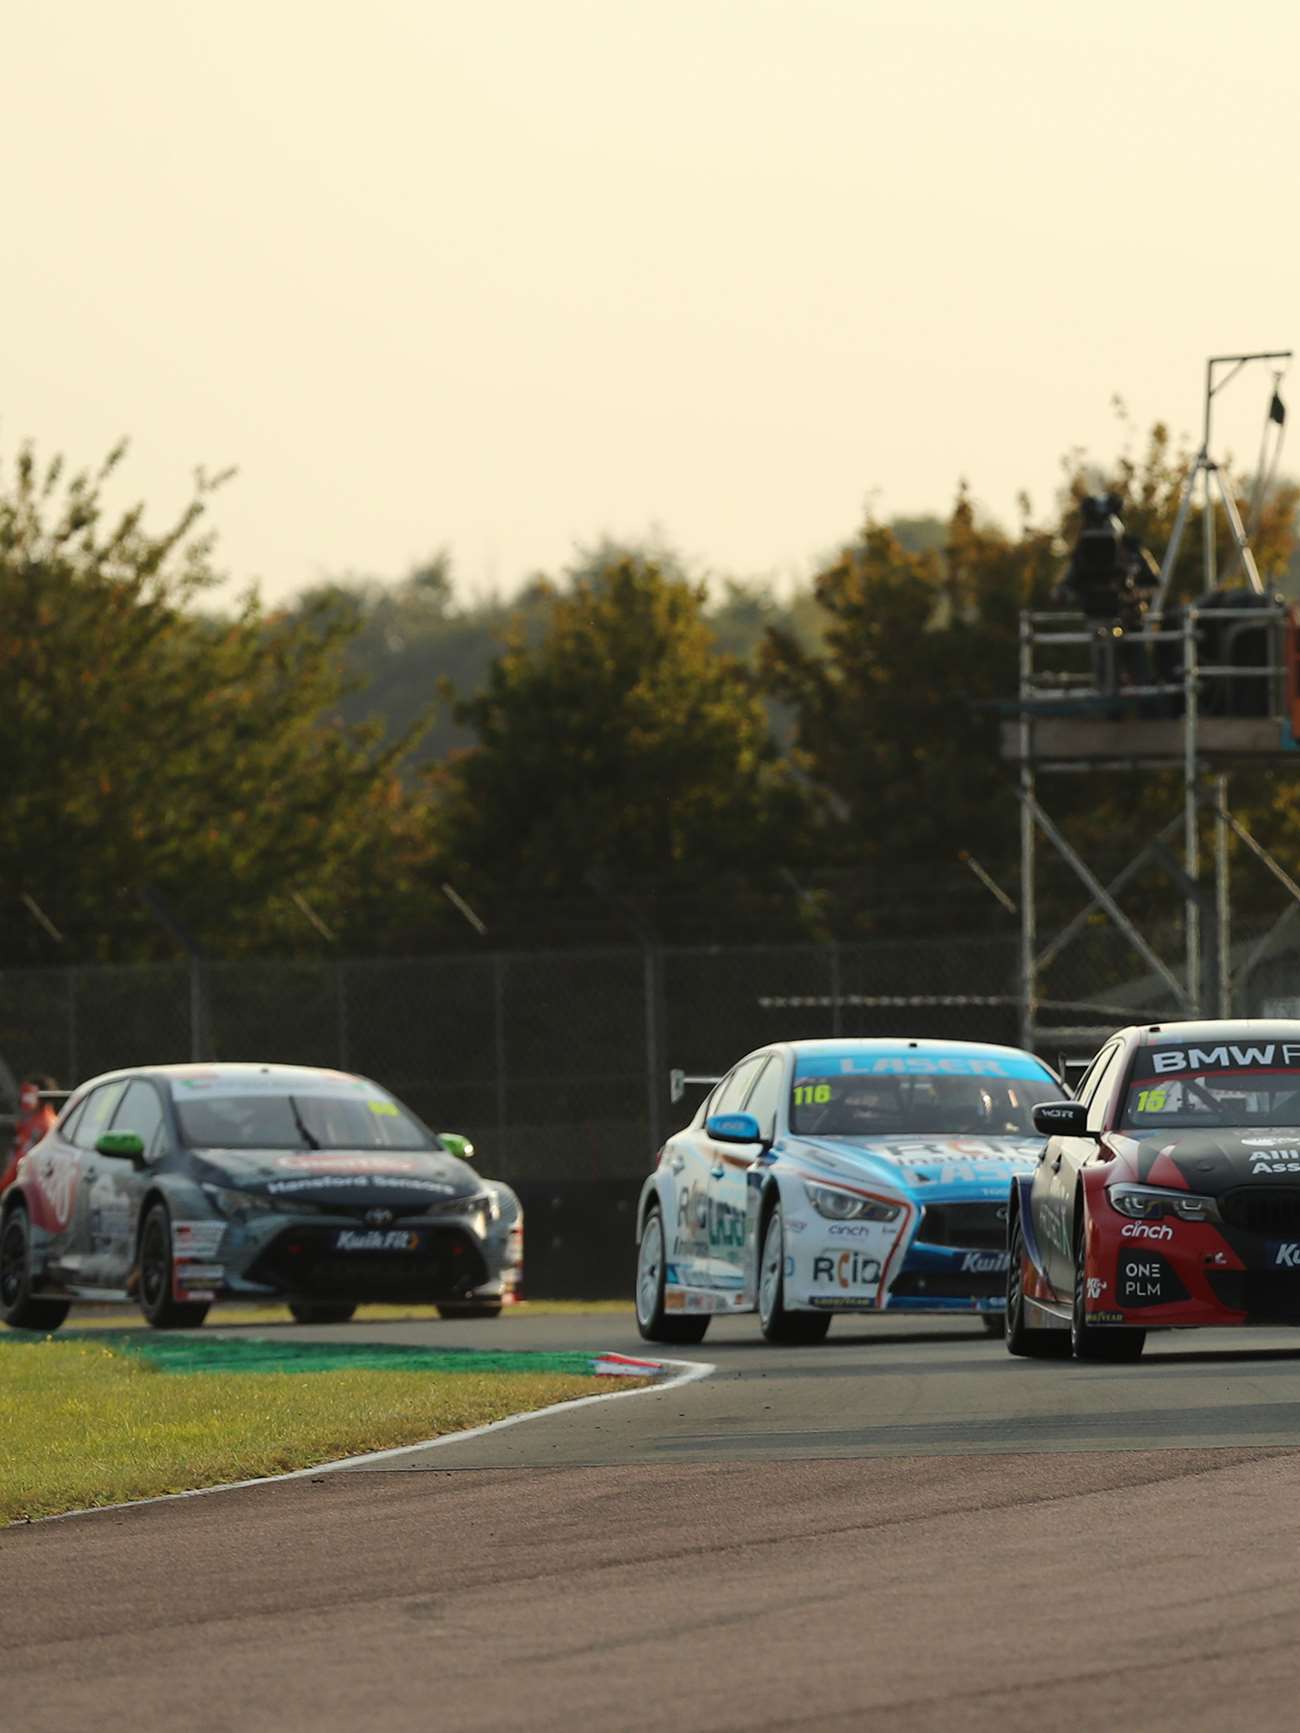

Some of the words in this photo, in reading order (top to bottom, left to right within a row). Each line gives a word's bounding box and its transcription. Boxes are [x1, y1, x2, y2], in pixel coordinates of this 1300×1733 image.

[828, 1223, 869, 1237] cinch
[1121, 1220, 1173, 1240] cinch
[1125, 1263, 1160, 1277] ONE
[1125, 1281, 1160, 1296] PLM
